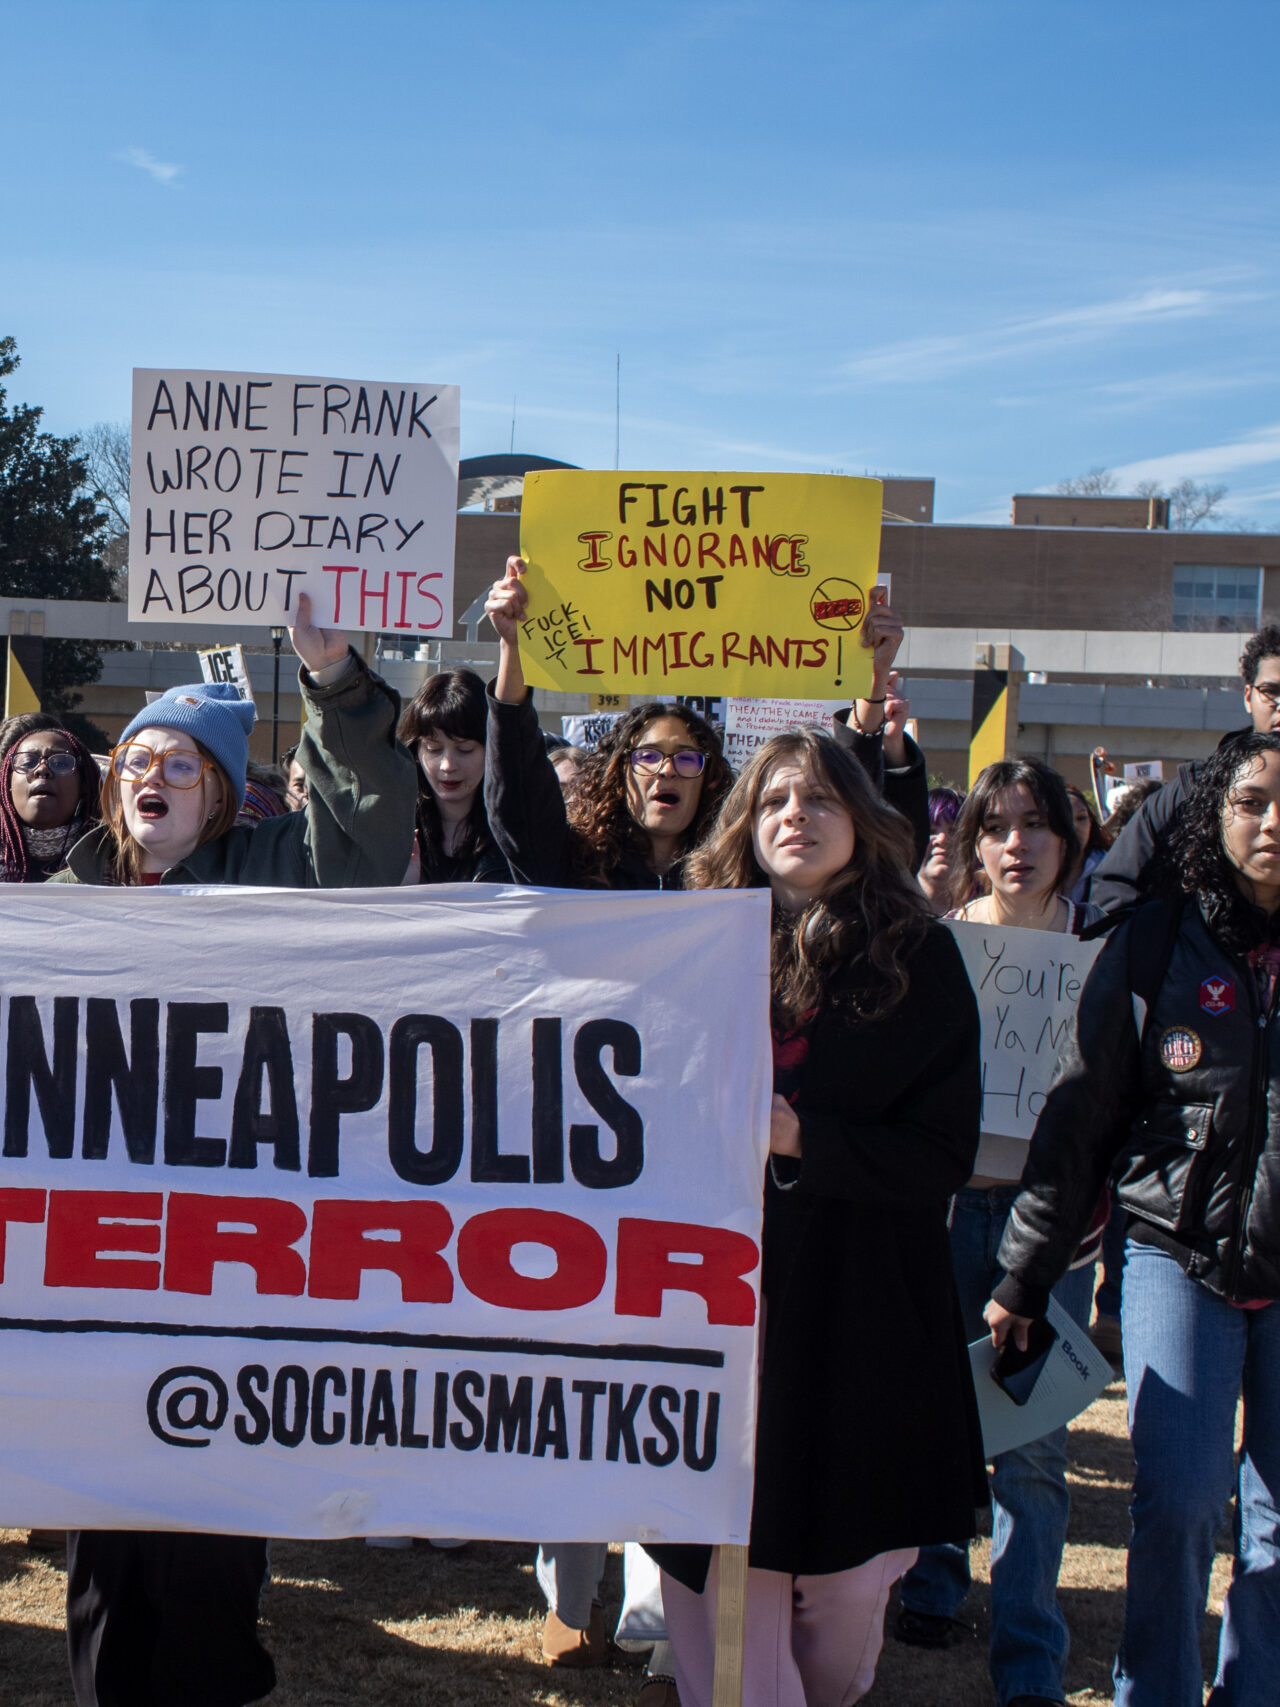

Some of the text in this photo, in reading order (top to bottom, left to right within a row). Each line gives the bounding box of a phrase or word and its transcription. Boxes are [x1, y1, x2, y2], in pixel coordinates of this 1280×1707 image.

[147, 379, 438, 438] ANNE FRANK
[147, 445, 402, 499] WROTE IN
[618, 482, 765, 528] FIGHT
[145, 507, 425, 555] HER DIARY
[577, 530, 810, 577] IGNORANCE
[141, 564, 444, 629] ABOUT THIS
[645, 575, 724, 612] NOT
[521, 602, 579, 640] FUCK
[207, 650, 238, 683] ICE
[598, 694, 620, 706] 395
[729, 704, 760, 715] THEN
[762, 707, 791, 718] THEY
[793, 709, 819, 720] CAME
[737, 715, 751, 723] and
[726, 733, 765, 748] THEN
[980, 938, 1081, 1001] You're
[994, 1004, 1026, 1052] Ya
[1061, 1339, 1091, 1382] Book
[146, 1364, 721, 1472] @SOCIALISMATKSU
